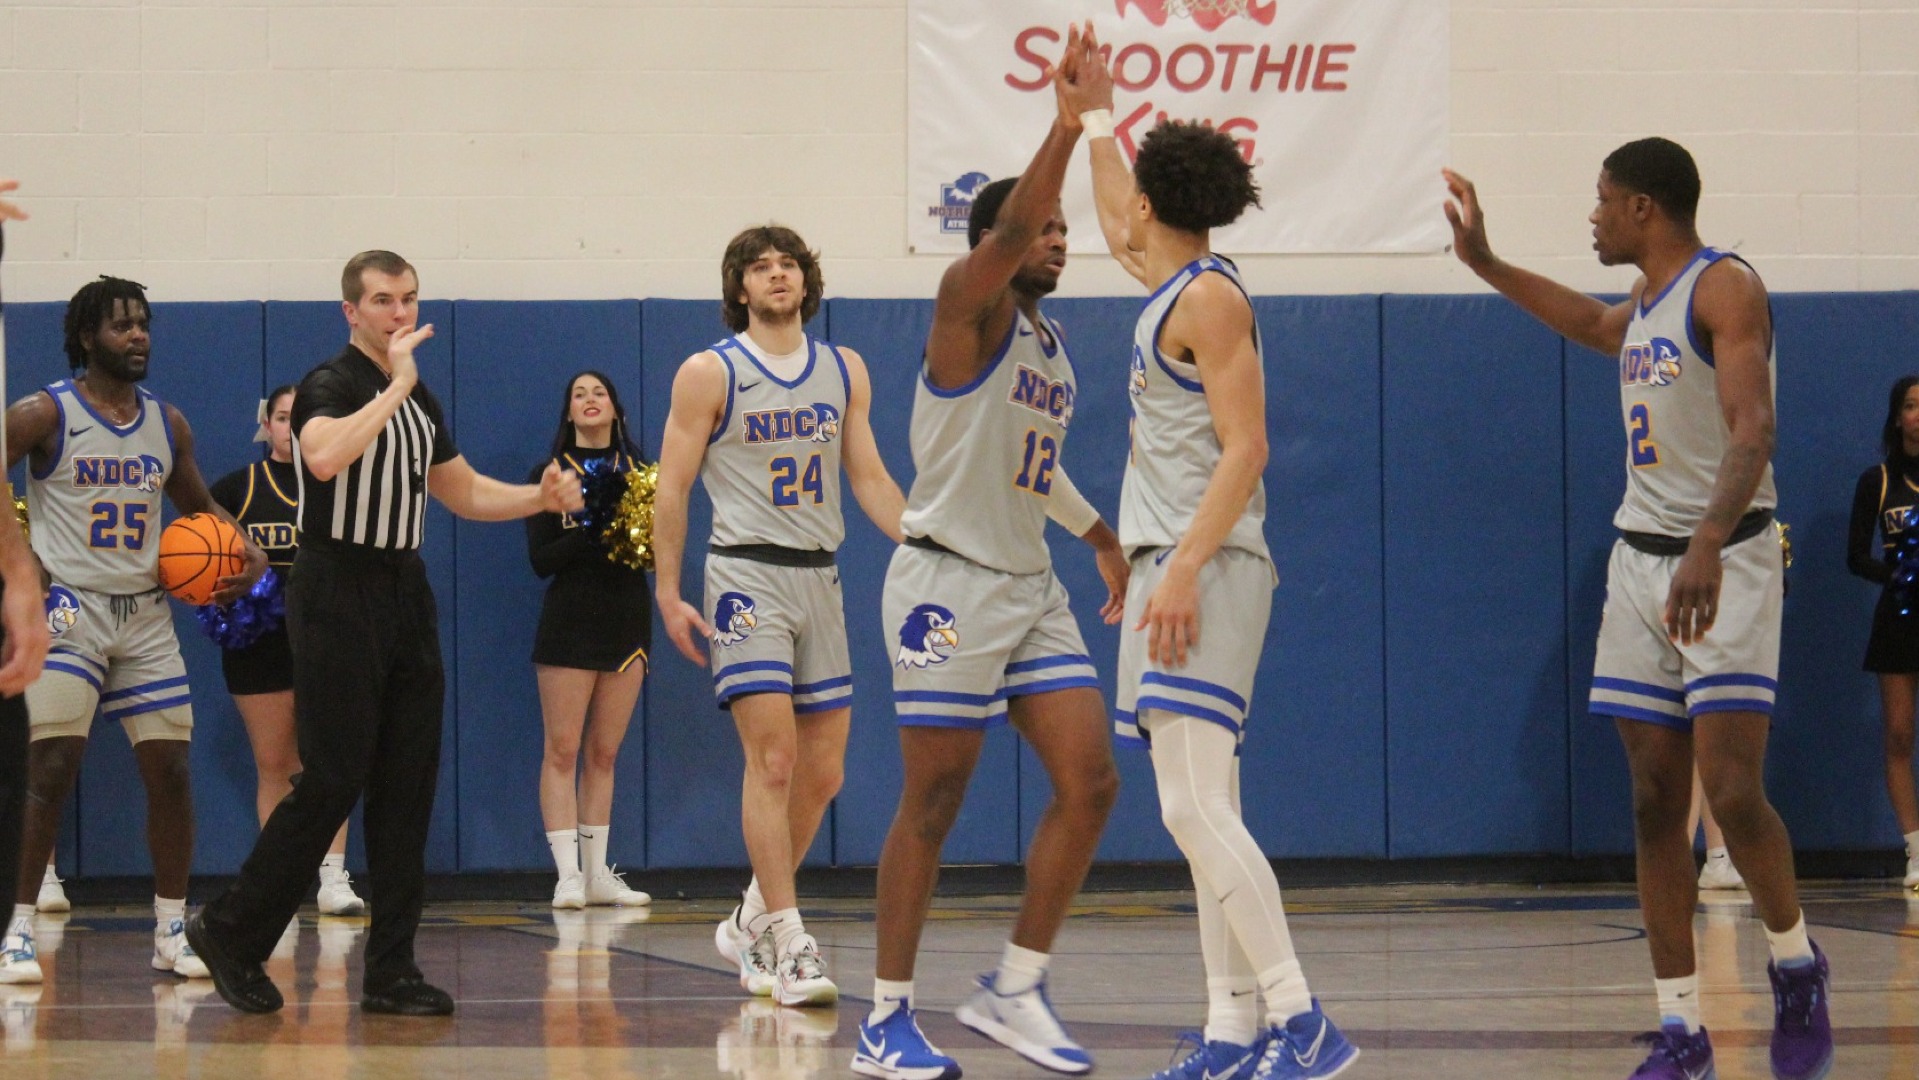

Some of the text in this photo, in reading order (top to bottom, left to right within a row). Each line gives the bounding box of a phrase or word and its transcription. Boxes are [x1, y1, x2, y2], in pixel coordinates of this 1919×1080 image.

[1004, 27, 1356, 93] SOOTHIE
[1114, 101, 1258, 165] KG
[1008, 363, 1066, 420] NDC
[743, 406, 817, 444] NDC
[1630, 401, 1661, 469] 2
[72, 456, 143, 489] NDC
[769, 450, 824, 508] 24
[1011, 426, 1057, 497] 12
[88, 499, 149, 552] 25
[248, 523, 299, 549] ND
